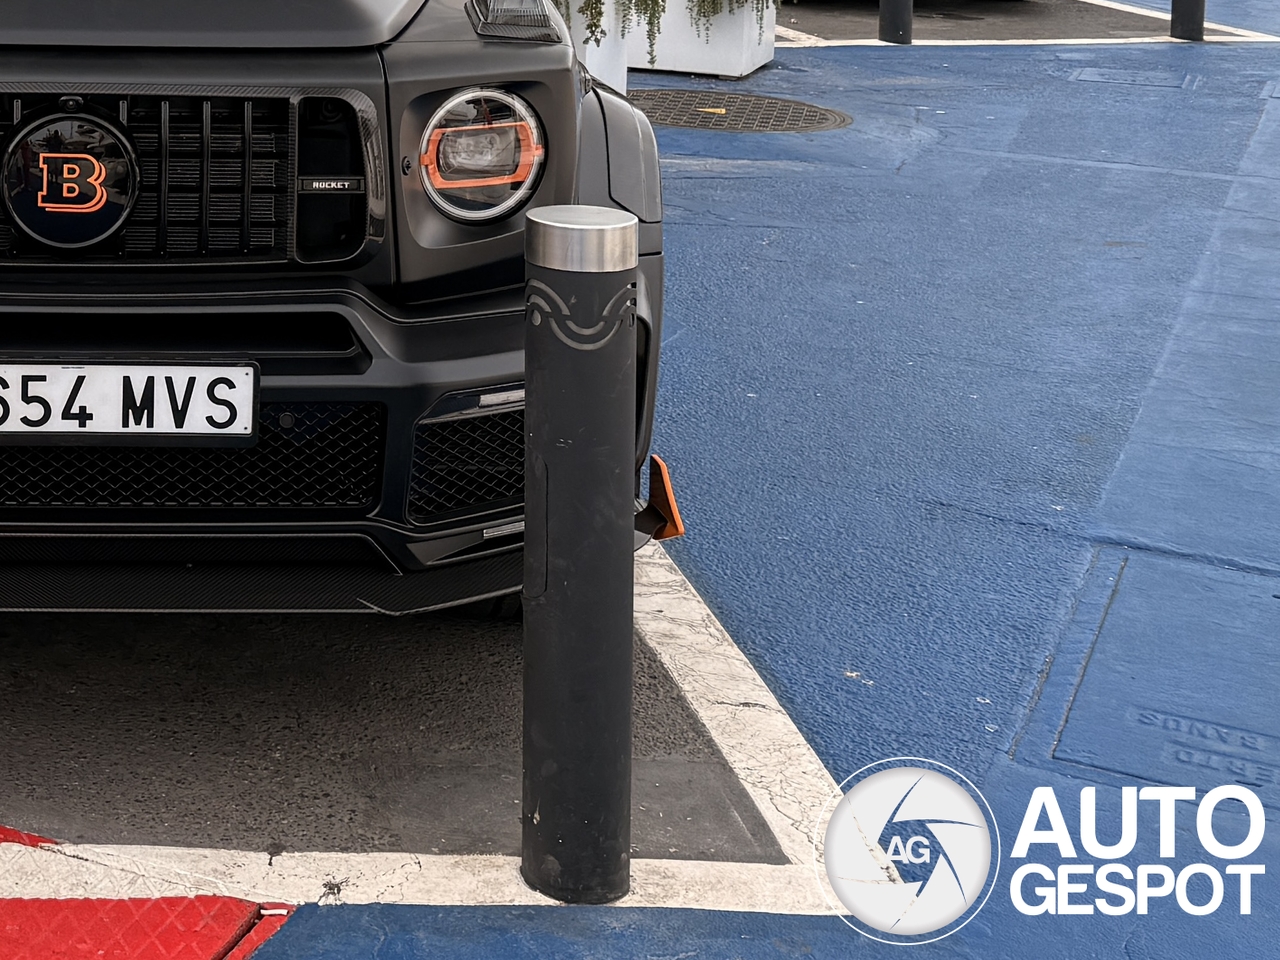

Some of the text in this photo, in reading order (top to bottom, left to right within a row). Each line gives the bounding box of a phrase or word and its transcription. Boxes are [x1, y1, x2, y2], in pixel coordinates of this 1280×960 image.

[37, 152, 108, 212] B
[312, 181, 350, 189] ROCKET
[121, 375, 238, 429] MVS
